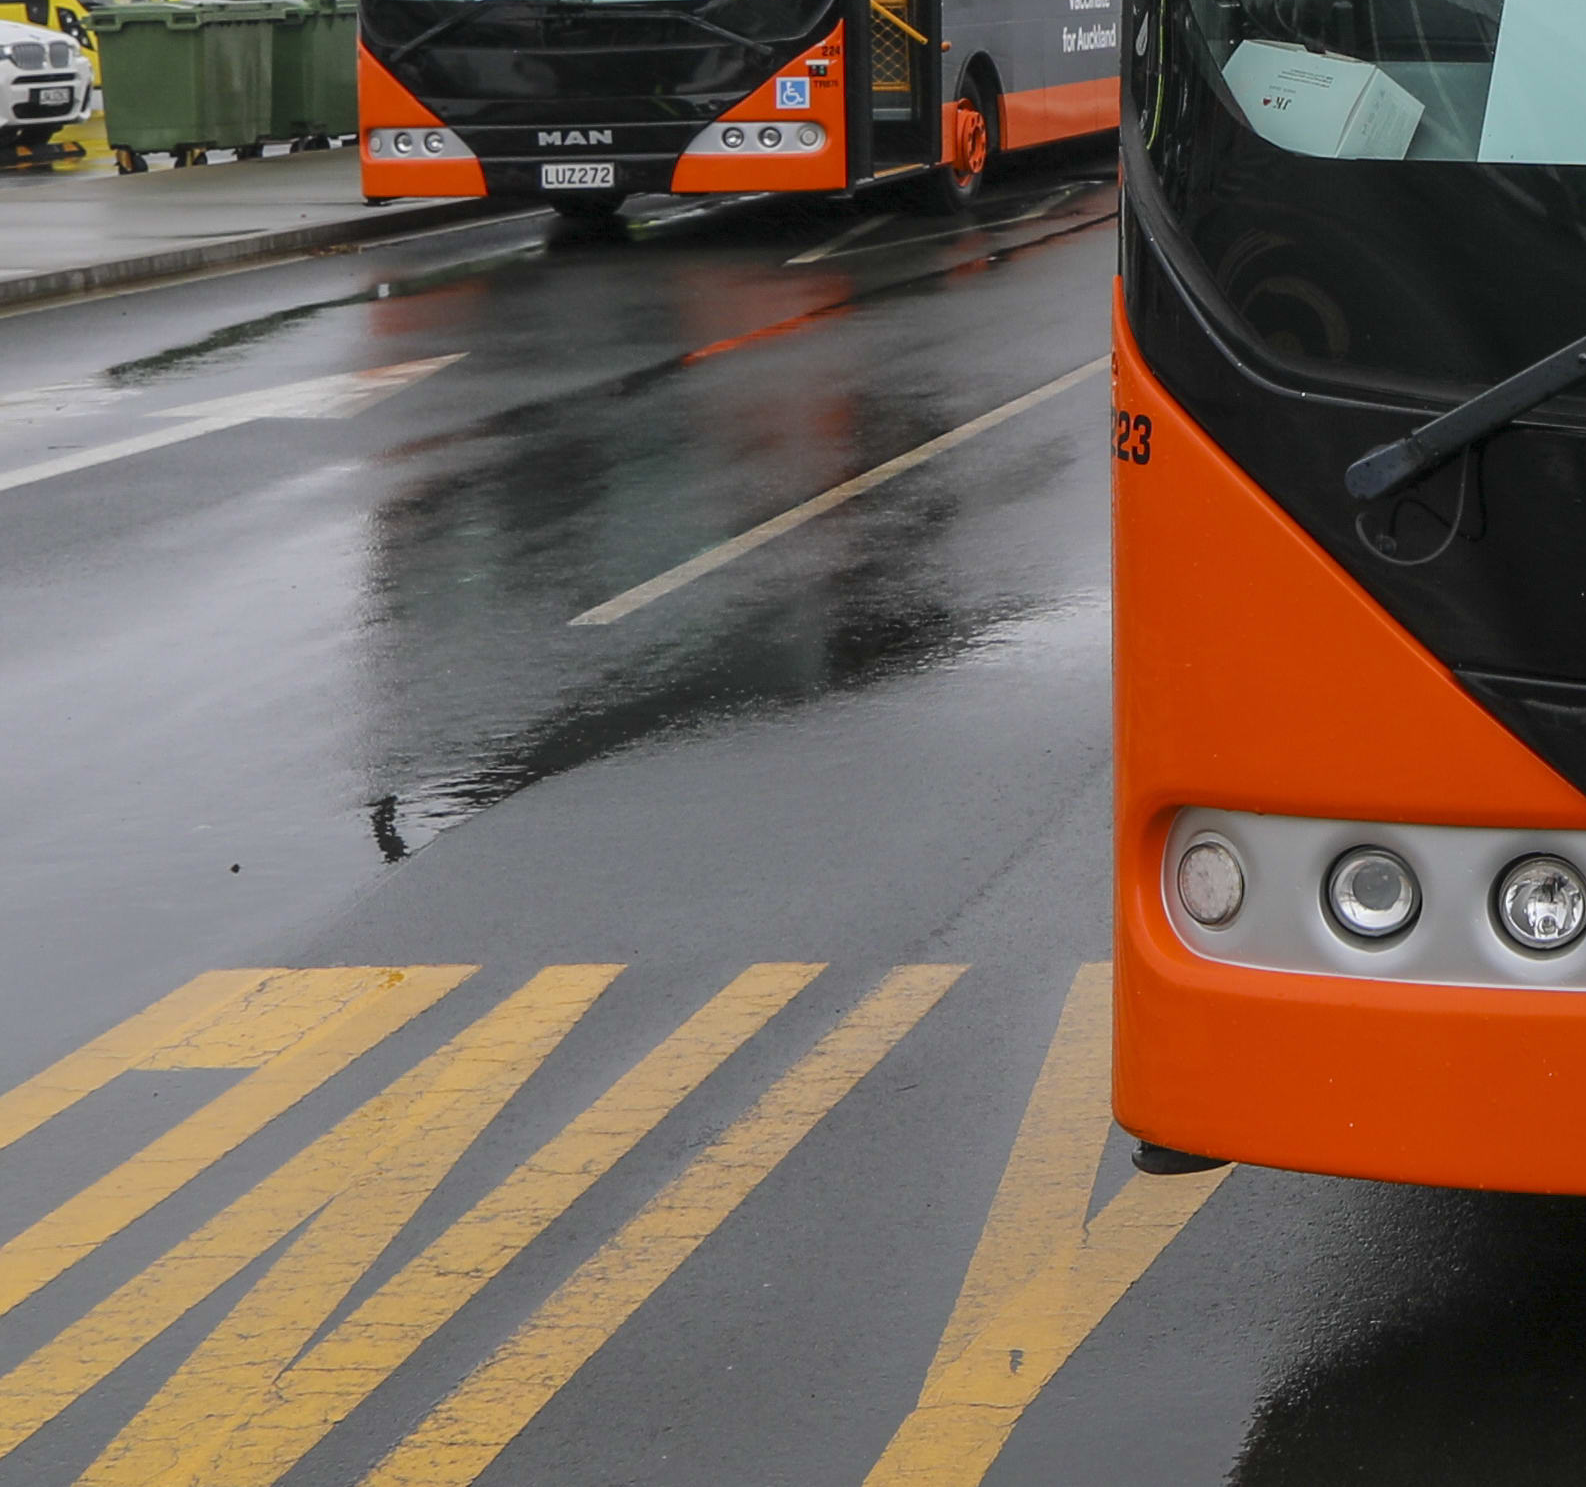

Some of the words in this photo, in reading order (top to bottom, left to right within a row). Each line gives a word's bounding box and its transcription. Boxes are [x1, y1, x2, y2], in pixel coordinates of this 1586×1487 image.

[1062, 26, 1076, 53] for
[1077, 22, 1116, 52] Auckland
[537, 129, 614, 147] MAN
[544, 166, 611, 185] LUZ272
[1111, 408, 1152, 465] 23
